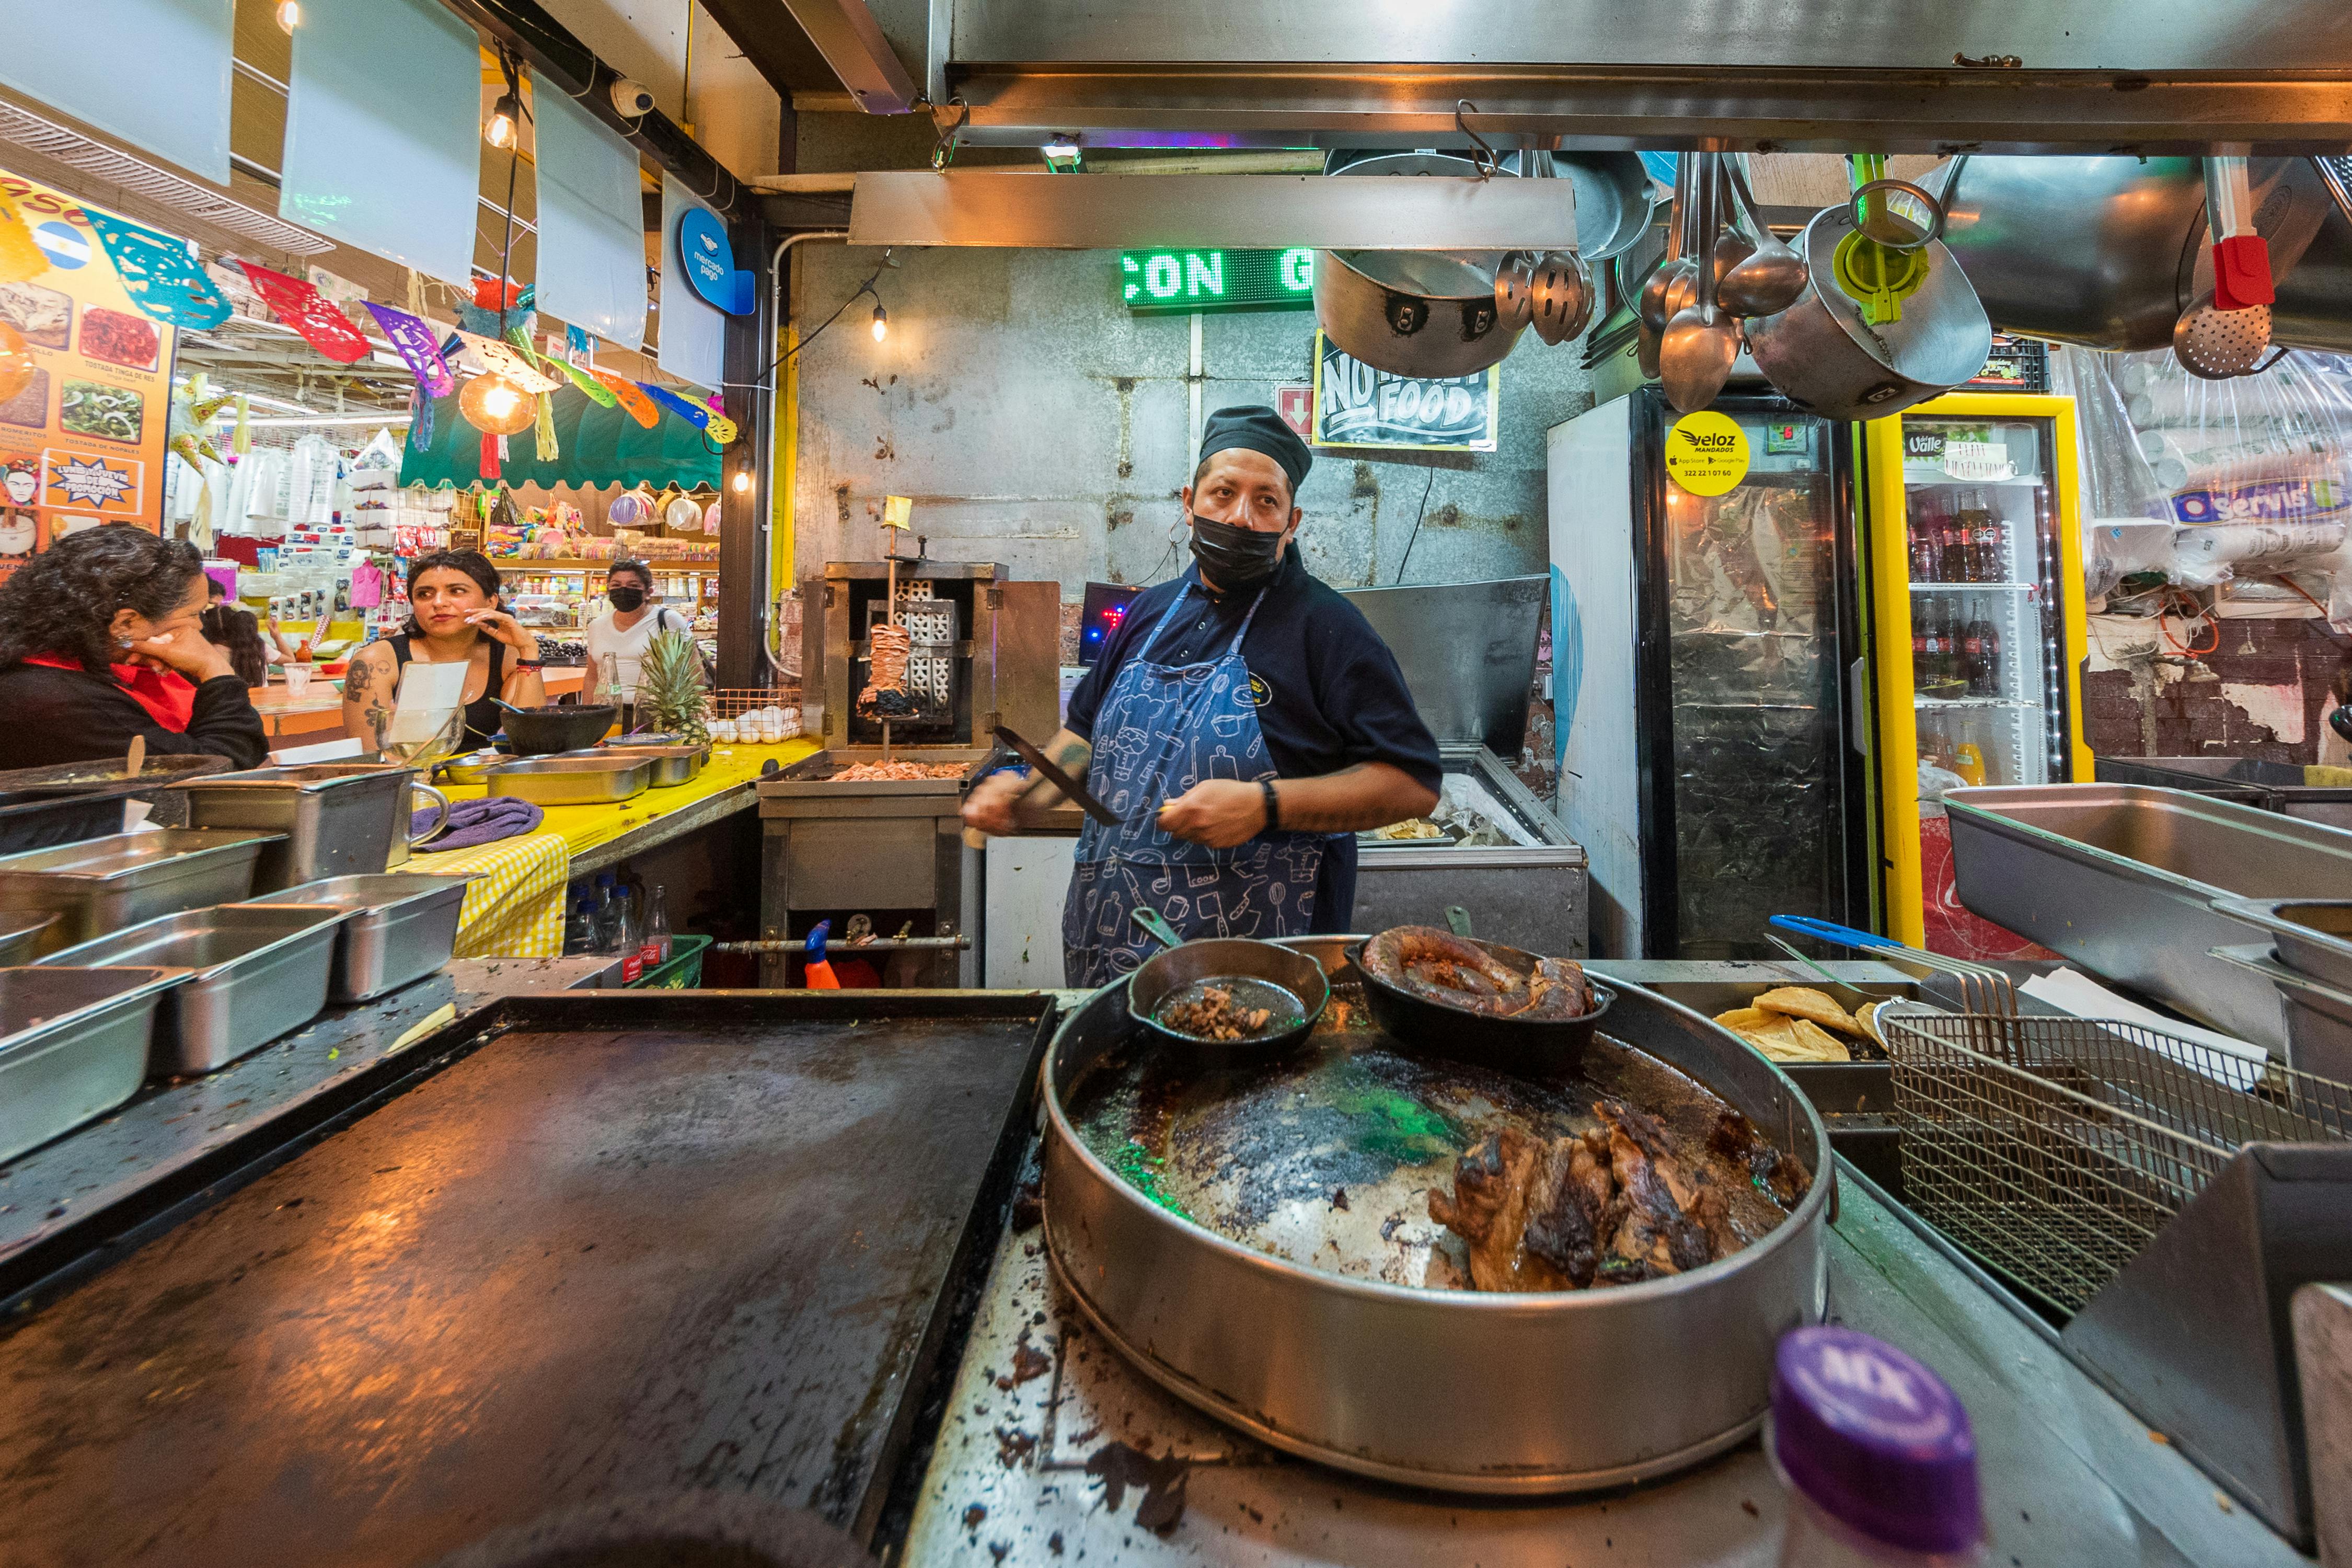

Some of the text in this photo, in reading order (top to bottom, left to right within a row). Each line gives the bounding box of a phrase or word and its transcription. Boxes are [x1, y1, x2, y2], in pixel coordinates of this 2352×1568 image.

[694, 251, 724, 275] mercado
[700, 264, 718, 281] pago
[30, 347, 53, 356] OLLO
[85, 360, 113, 373] TOSTADA
[114, 367, 134, 378] TINGA
[144, 374, 155, 383] RES
[1378, 381, 1472, 426] FOOD
[65, 438, 97, 448] TOSTADA
[110, 446, 140, 455] NOPALES
[1690, 432, 1736, 446] veloz
[1909, 436, 1941, 453] Valle
[57, 465, 86, 475] LUNES
[94, 469, 129, 483] JUEVES
[86, 475, 99, 486] DE
[64, 482, 120, 497] PROMOCIÓN
